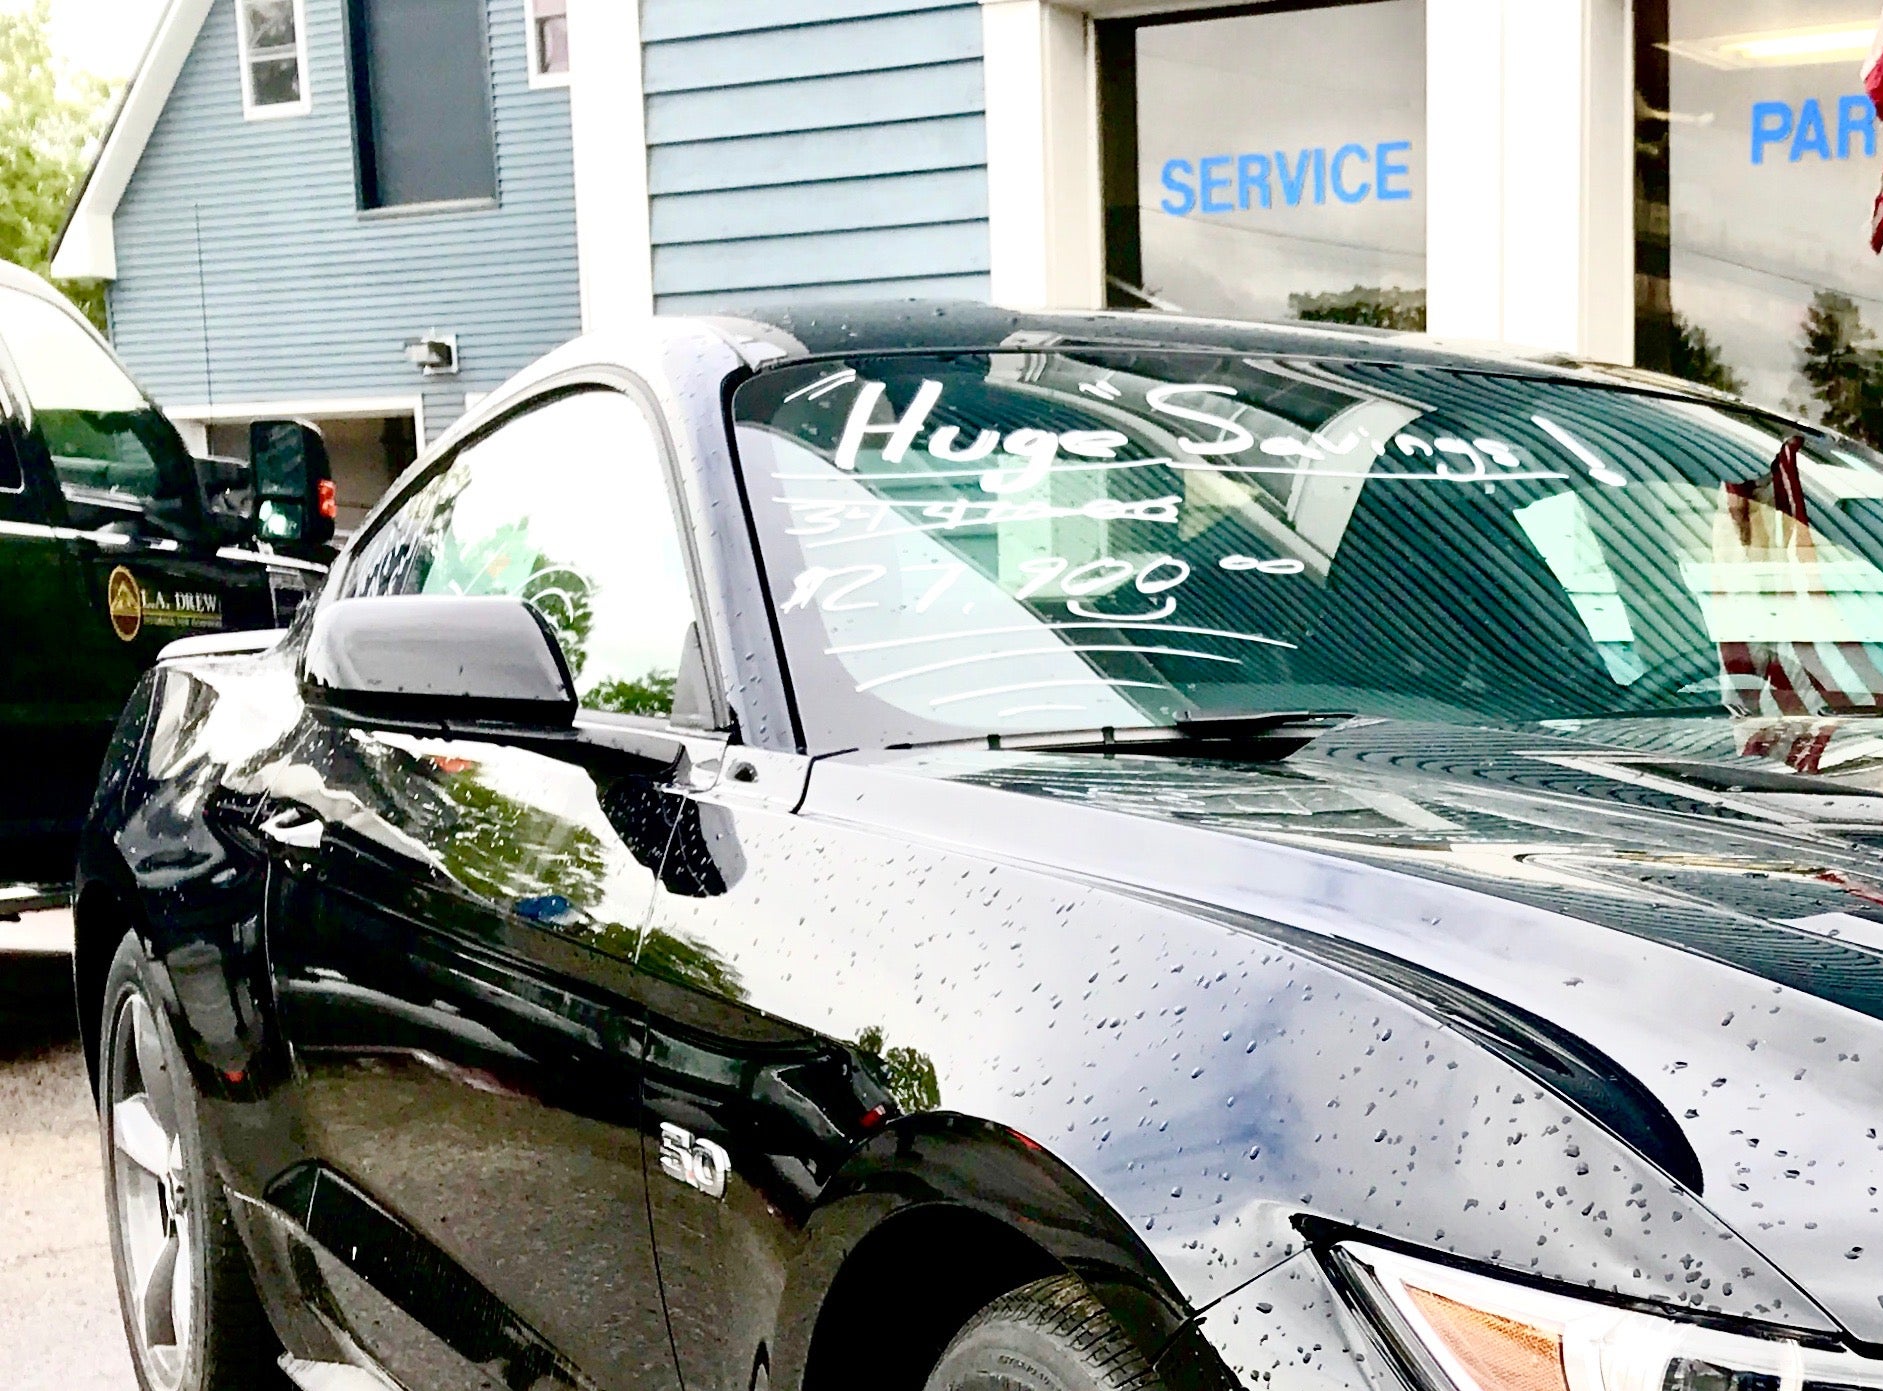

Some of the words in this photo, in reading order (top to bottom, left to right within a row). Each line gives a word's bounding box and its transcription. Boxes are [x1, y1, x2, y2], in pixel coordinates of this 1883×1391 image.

[1160, 141, 1412, 217] SERVICE
[141, 588, 170, 610] L.A.
[175, 591, 217, 613] DREW
